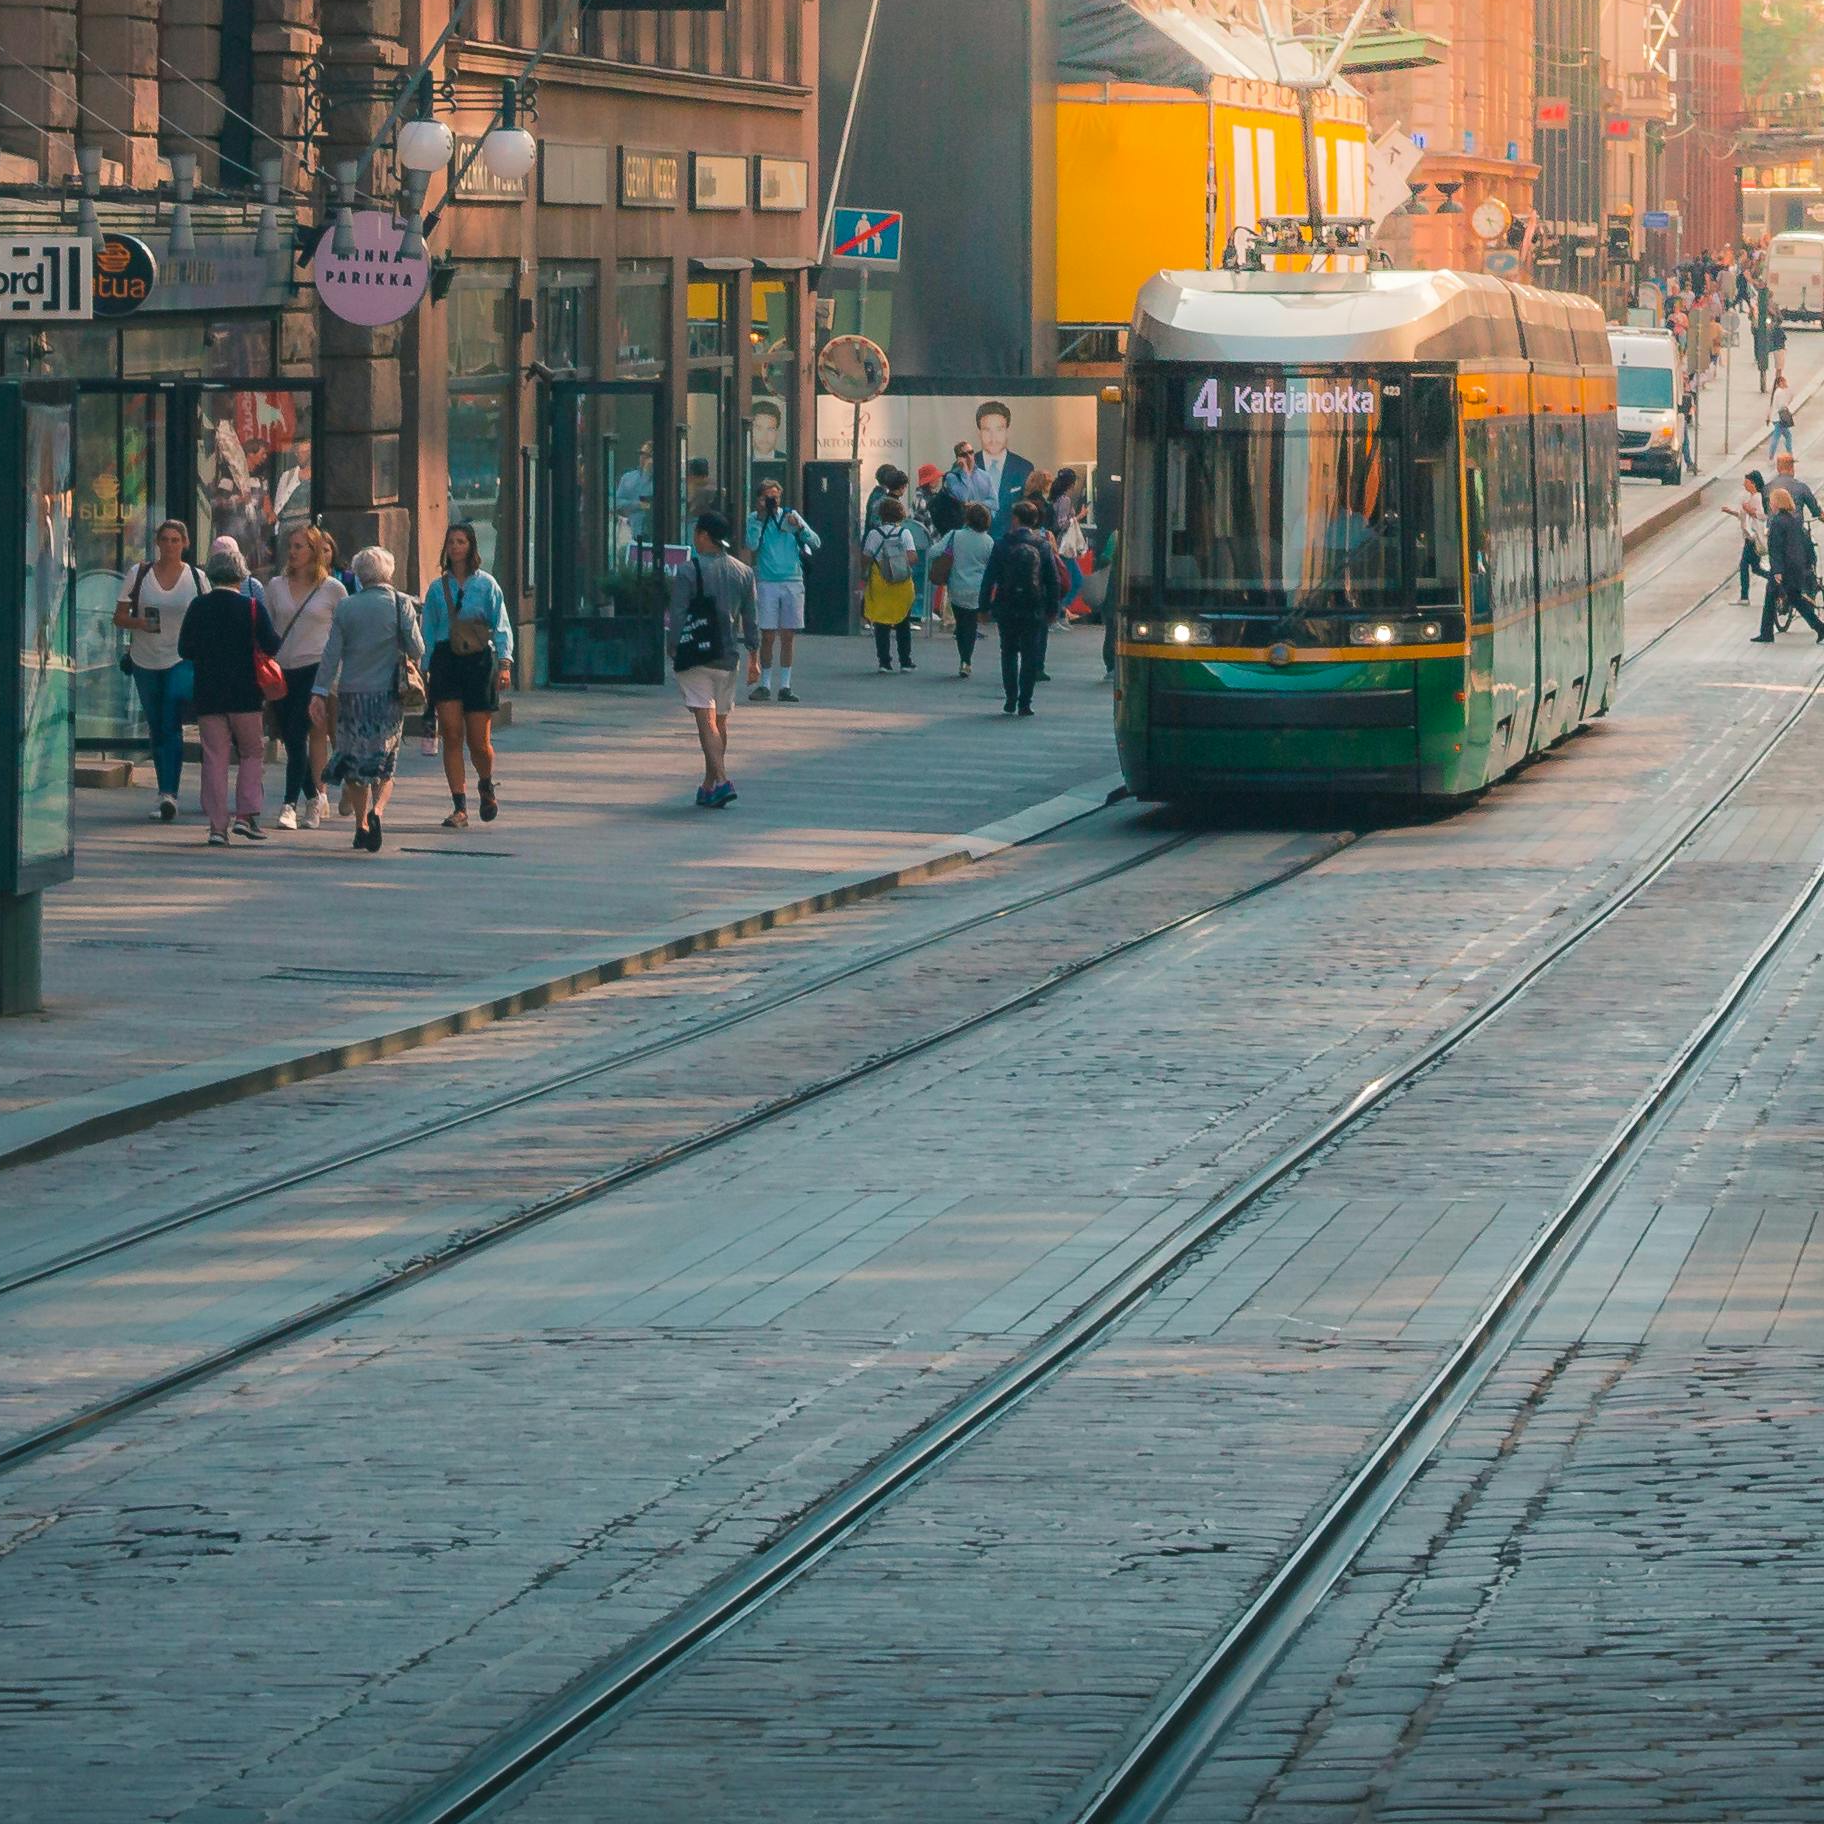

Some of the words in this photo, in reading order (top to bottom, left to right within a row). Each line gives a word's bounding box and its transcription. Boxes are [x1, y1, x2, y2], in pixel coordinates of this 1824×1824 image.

[325, 271, 413, 287] PARIKKA
[1382, 385, 1401, 397] 423
[1192, 378, 1223, 427] 4
[1234, 385, 1374, 419] Katajanokka
[870, 438, 904, 448] ROSSI
